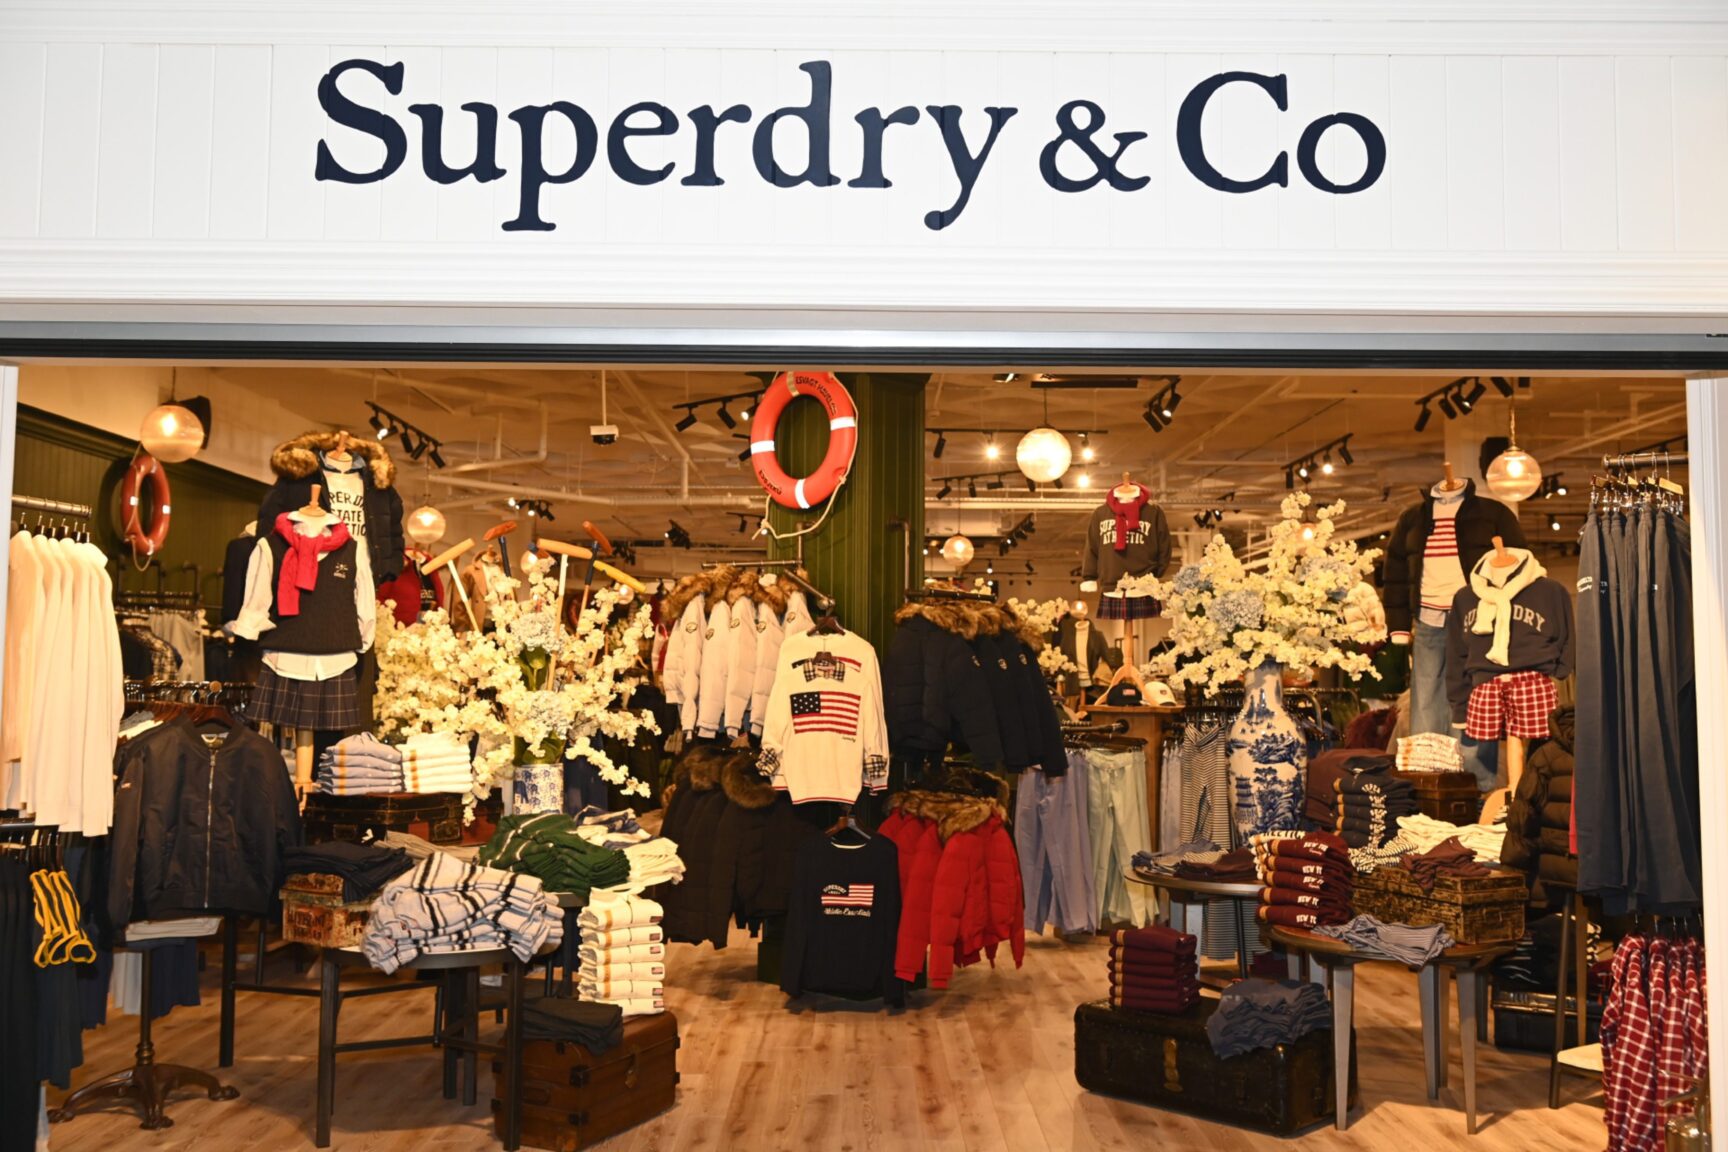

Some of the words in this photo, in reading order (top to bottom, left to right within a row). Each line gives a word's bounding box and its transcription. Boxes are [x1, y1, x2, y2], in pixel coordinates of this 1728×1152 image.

[315, 59, 1018, 231] Superdry
[1040, 100, 1150, 192] &
[1177, 72, 1386, 194] Co
